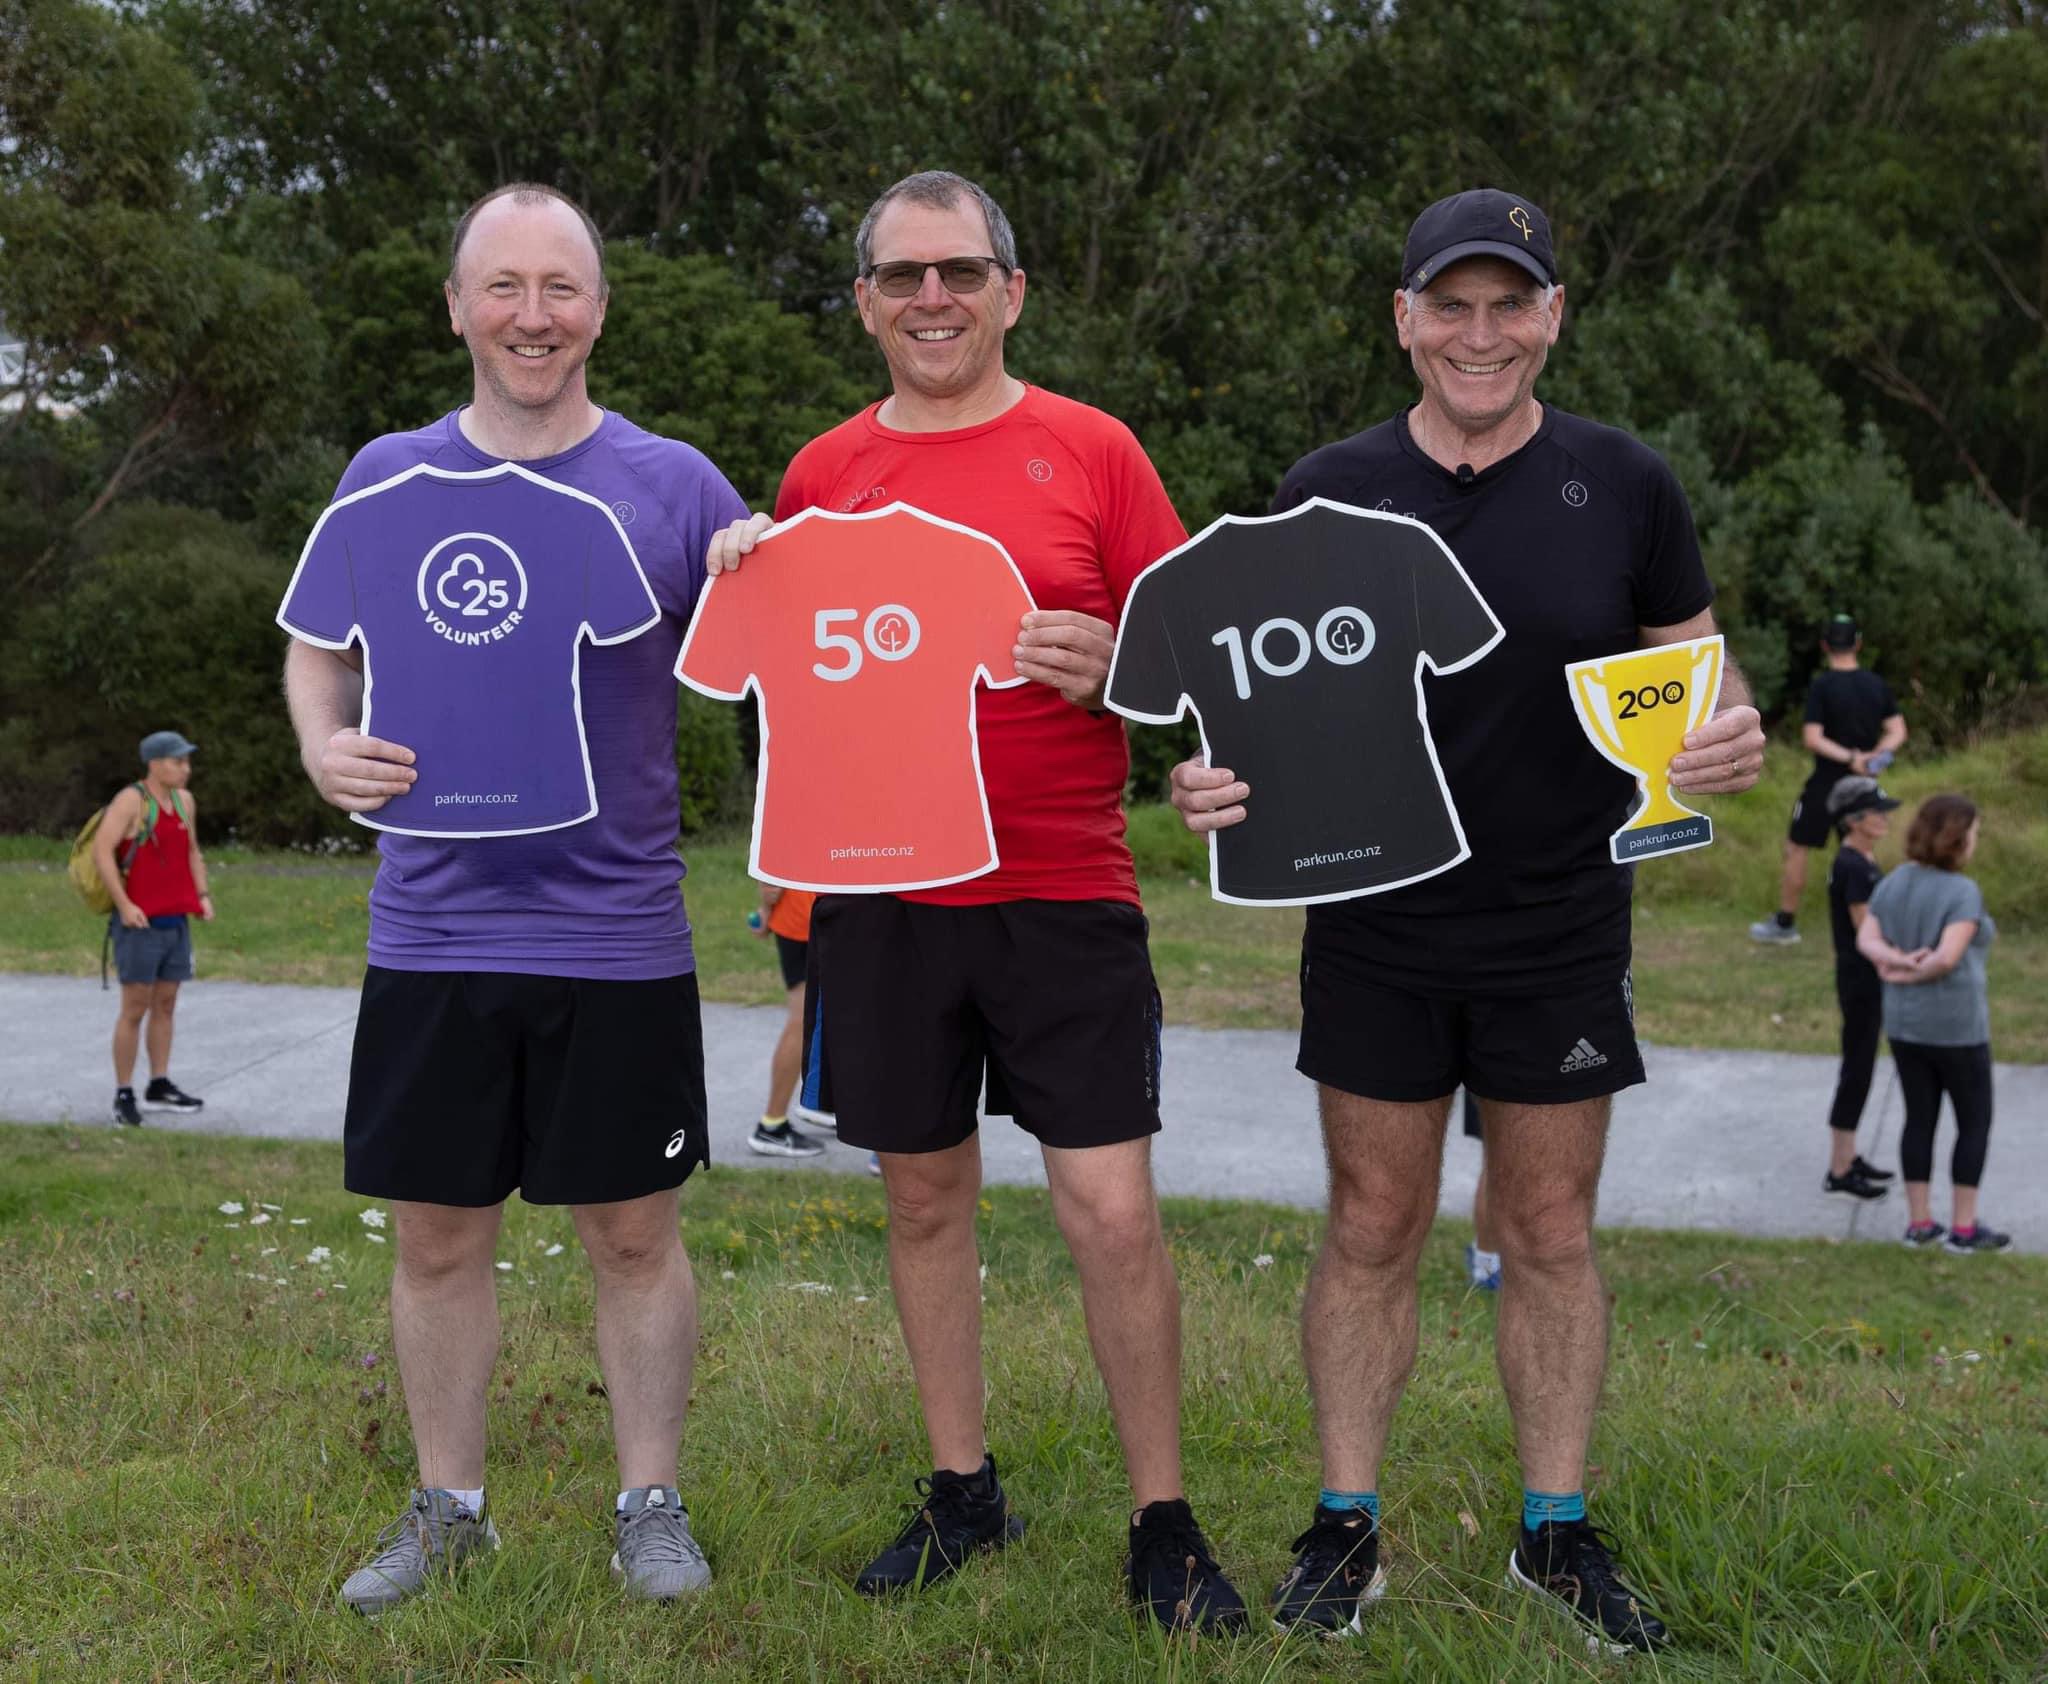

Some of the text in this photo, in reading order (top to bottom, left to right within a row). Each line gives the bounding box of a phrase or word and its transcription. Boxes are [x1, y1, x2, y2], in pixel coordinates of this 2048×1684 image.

[462, 579, 509, 616] 25
[425, 610, 523, 646] VOLUNTEER
[813, 604, 921, 682] 50
[1211, 606, 1377, 700] 100
[1617, 680, 1685, 720] 200
[434, 791, 519, 807] parkrun.co.nz
[830, 845, 915, 862] parkrun.co.nz
[1629, 827, 1699, 851] parkrun.co.nz
[1293, 845, 1382, 872] parkrun.co.nz
[1560, 1054, 1608, 1073] adidas
